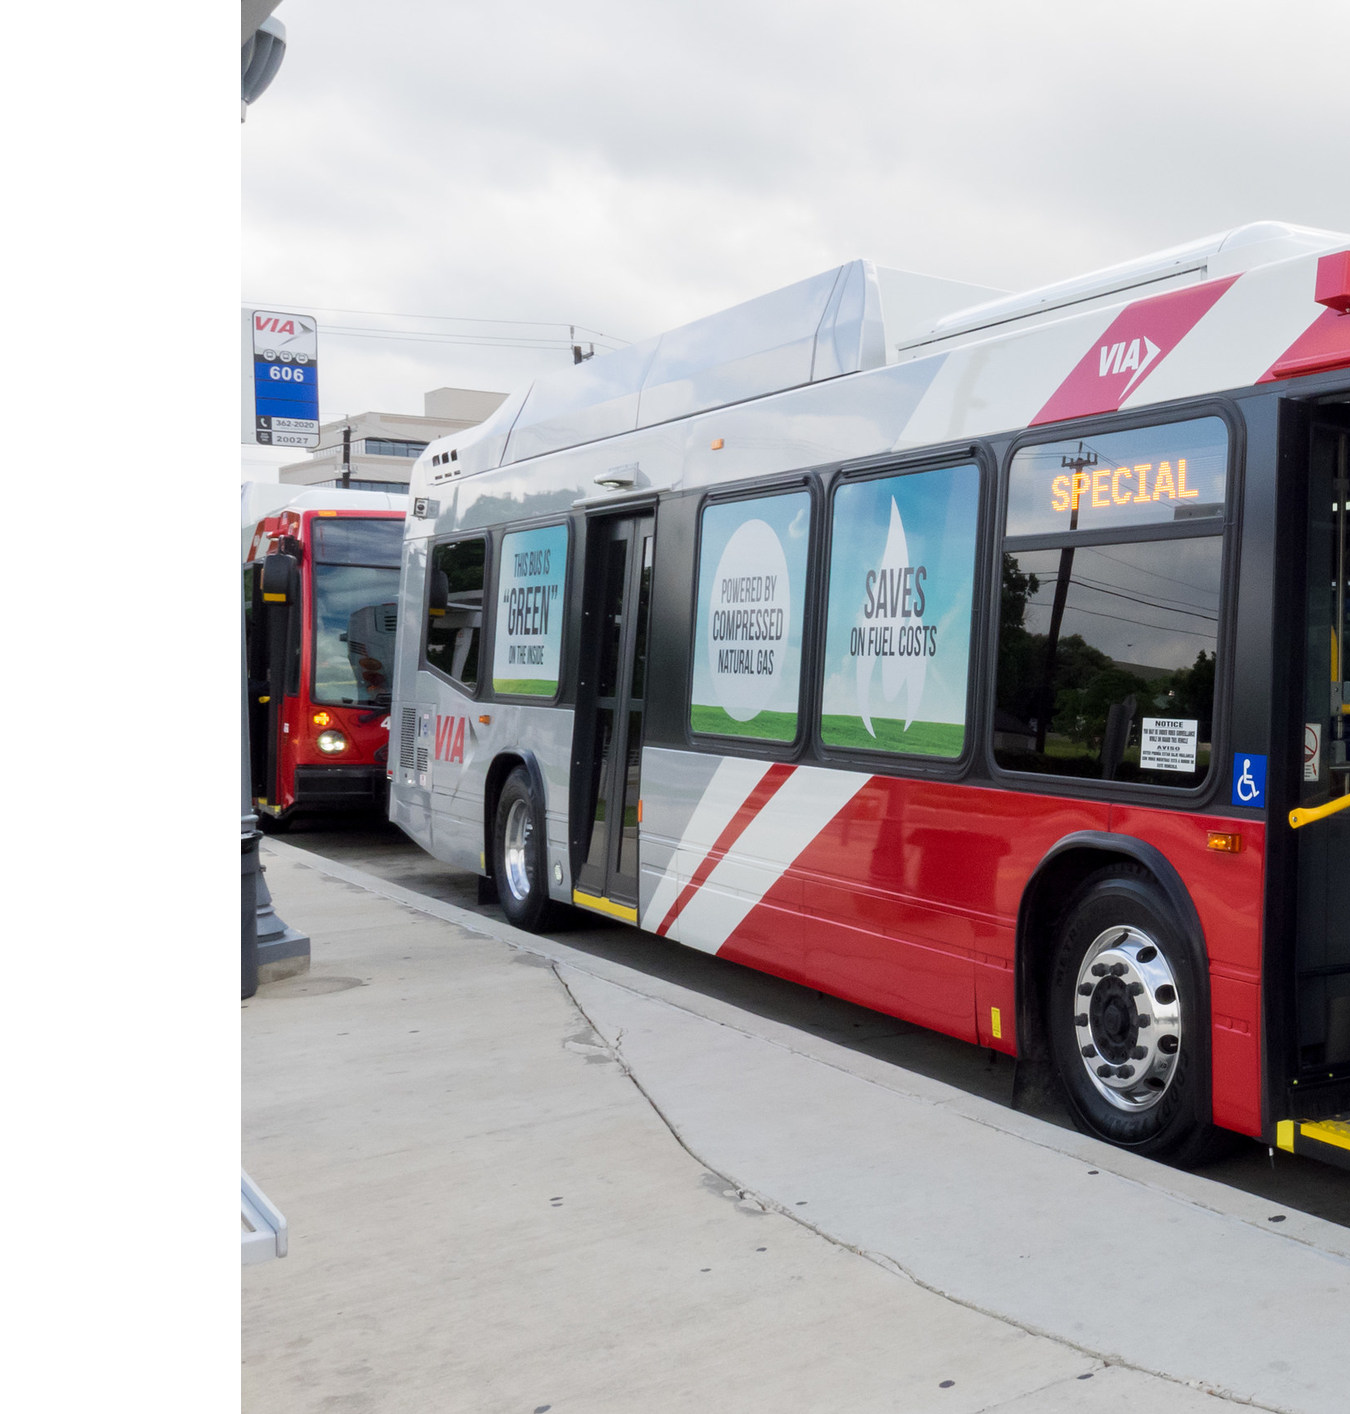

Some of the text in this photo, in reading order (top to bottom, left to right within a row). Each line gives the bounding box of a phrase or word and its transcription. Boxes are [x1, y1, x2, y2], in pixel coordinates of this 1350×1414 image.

[255, 315, 295, 335] VIA
[1098, 338, 1141, 377] VIA
[269, 366, 304, 382] 606
[276, 419, 315, 429] 362-2020
[276, 435, 309, 444] 20027
[1051, 458, 1199, 512] SPECIAL
[514, 548, 551, 578] THIS BUS IS
[721, 574, 778, 604] POWERED BY
[864, 565, 927, 619] SAVES
[712, 608, 784, 641] COMPRESSED
[508, 645, 544, 665] ON THE INSIDE
[850, 625, 937, 657] ON FUEL COSTS
[717, 649, 775, 676] NATURAL GAS
[1155, 720, 1183, 728] NOTICE
[434, 714, 466, 765] VIA
